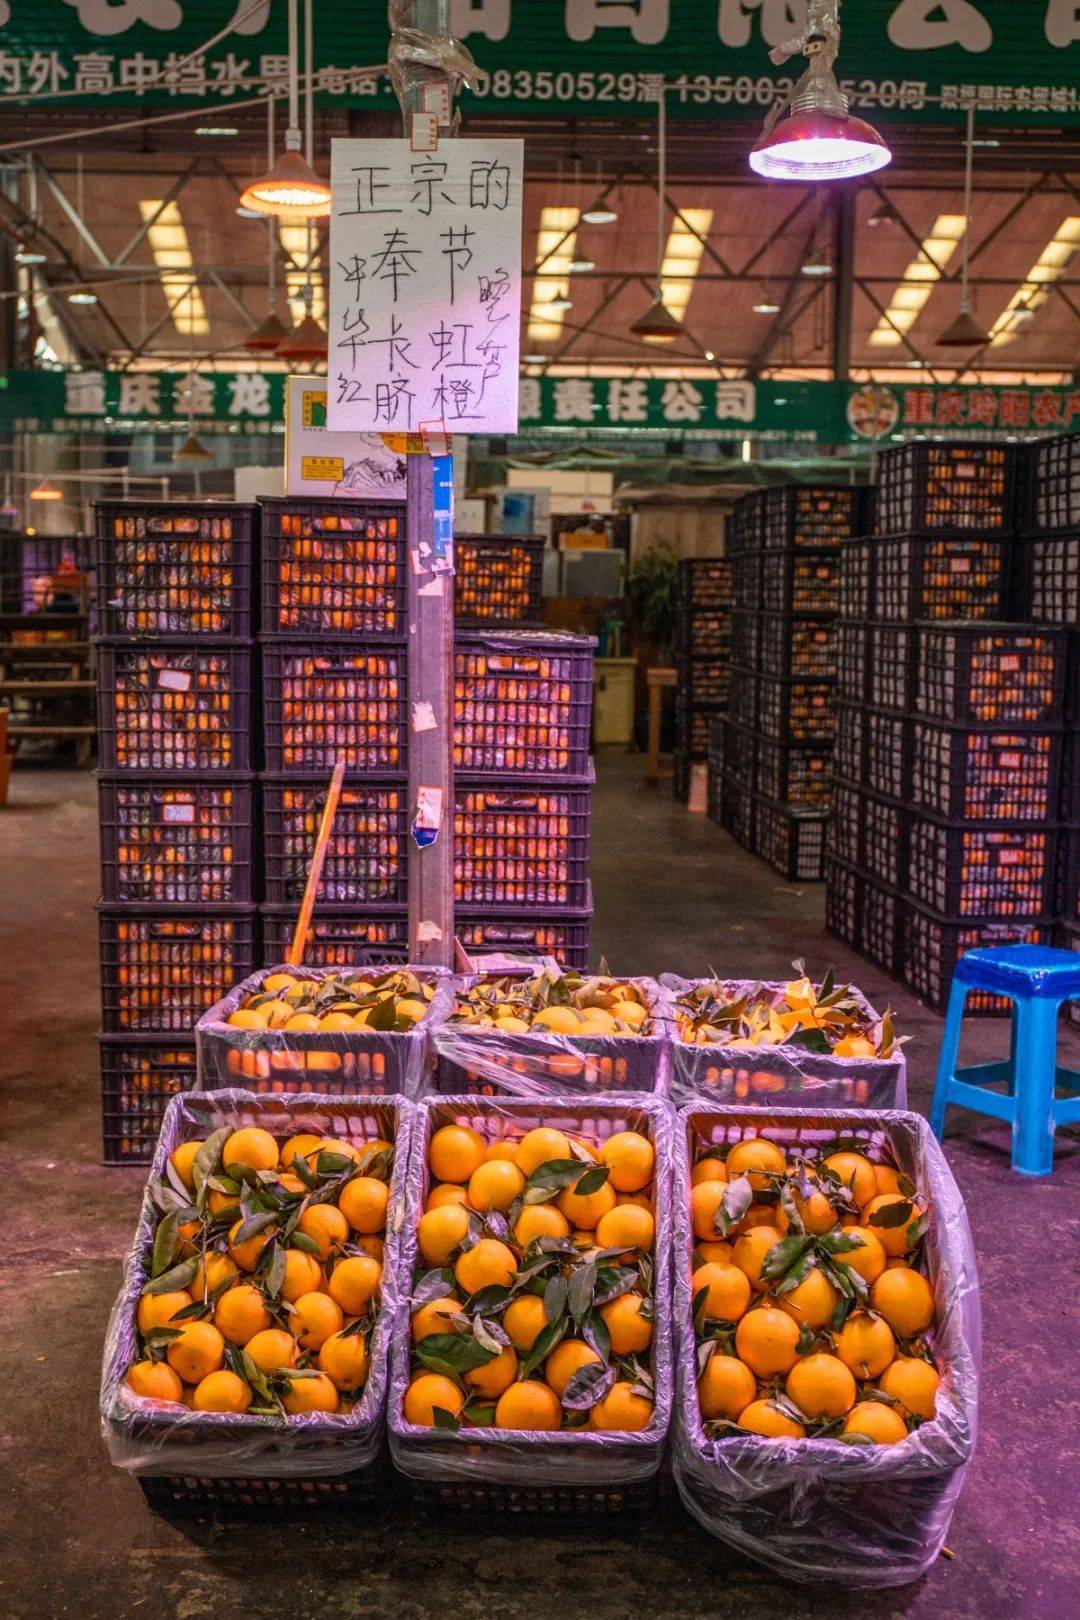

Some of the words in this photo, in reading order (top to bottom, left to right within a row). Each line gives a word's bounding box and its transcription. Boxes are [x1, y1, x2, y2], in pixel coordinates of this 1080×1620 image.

[339, 154, 509, 216] 正宗的
[371, 225, 476, 305] 奉节
[367, 314, 482, 372] 长虹
[64, 370, 271, 416] 重庆金龙
[373, 373, 486, 430] 脐橙
